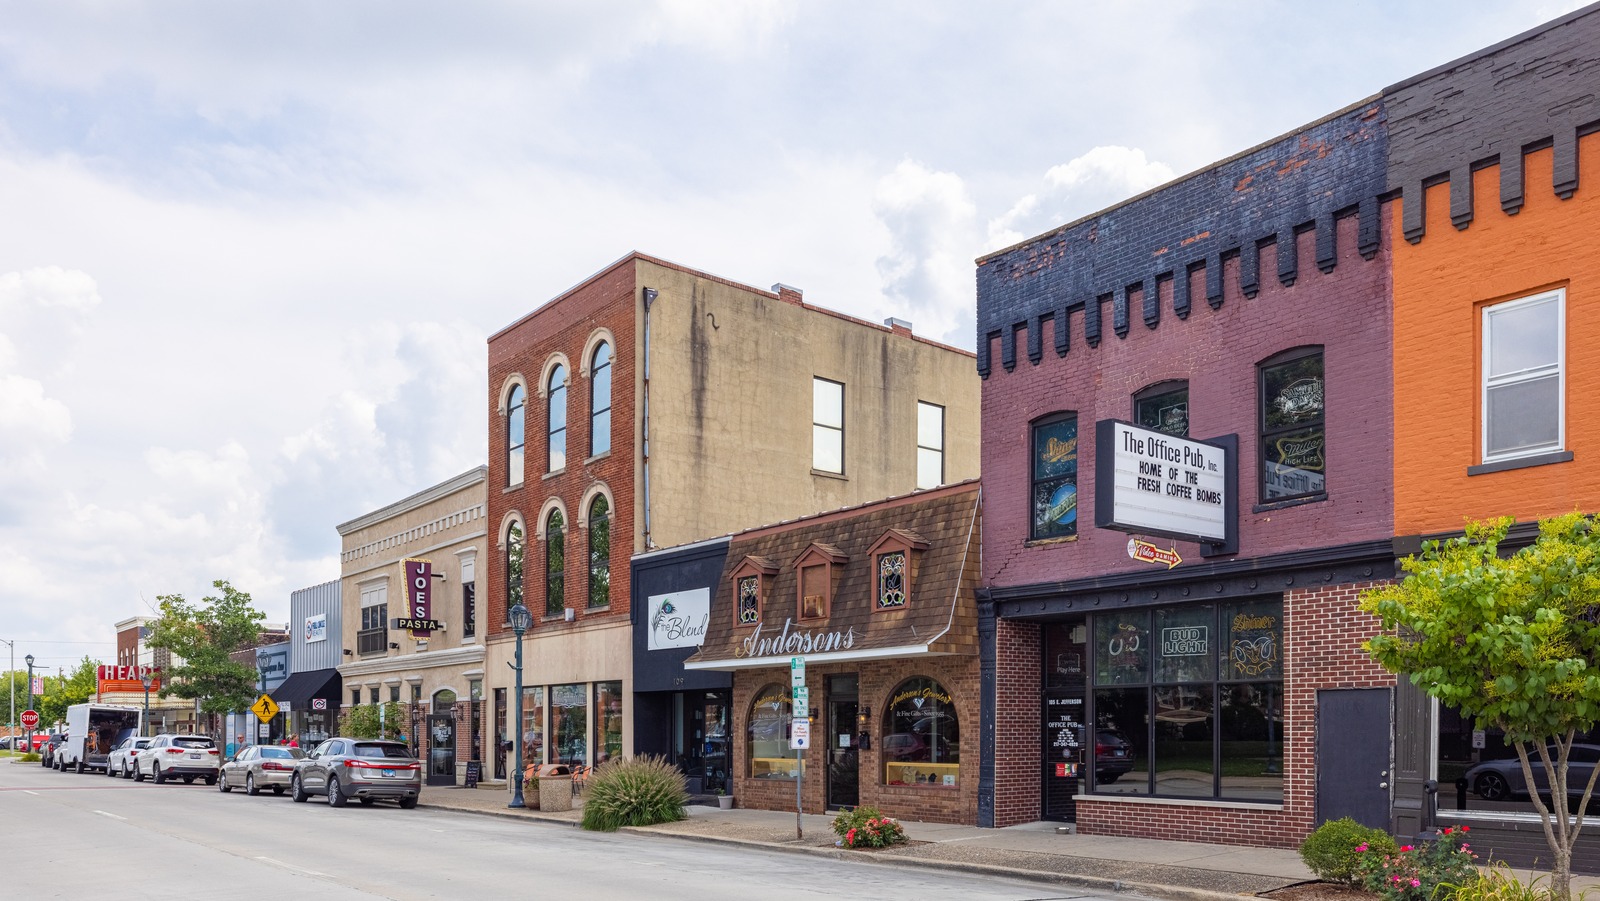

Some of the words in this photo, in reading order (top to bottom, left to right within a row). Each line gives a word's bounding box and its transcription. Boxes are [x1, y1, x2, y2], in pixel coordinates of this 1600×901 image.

[1122, 431, 1144, 455] The
[1147, 437, 1181, 463] Office
[1184, 446, 1206, 471] Pub,
[1139, 461, 1162, 477] HOME
[1169, 467, 1178, 480] OF
[1185, 471, 1198, 485] THE
[1137, 477, 1161, 493] FRESH
[1166, 483, 1192, 499] COFFEE
[1197, 488, 1222, 504] BOMBS
[415, 563, 427, 618] JOES
[400, 620, 436, 629] PASTA
[667, 613, 708, 640] Blend
[1170, 629, 1199, 641] BUD
[1231, 613, 1275, 632] Shiner
[735, 618, 855, 658] Andersons
[1165, 640, 1206, 653] LIGHT
